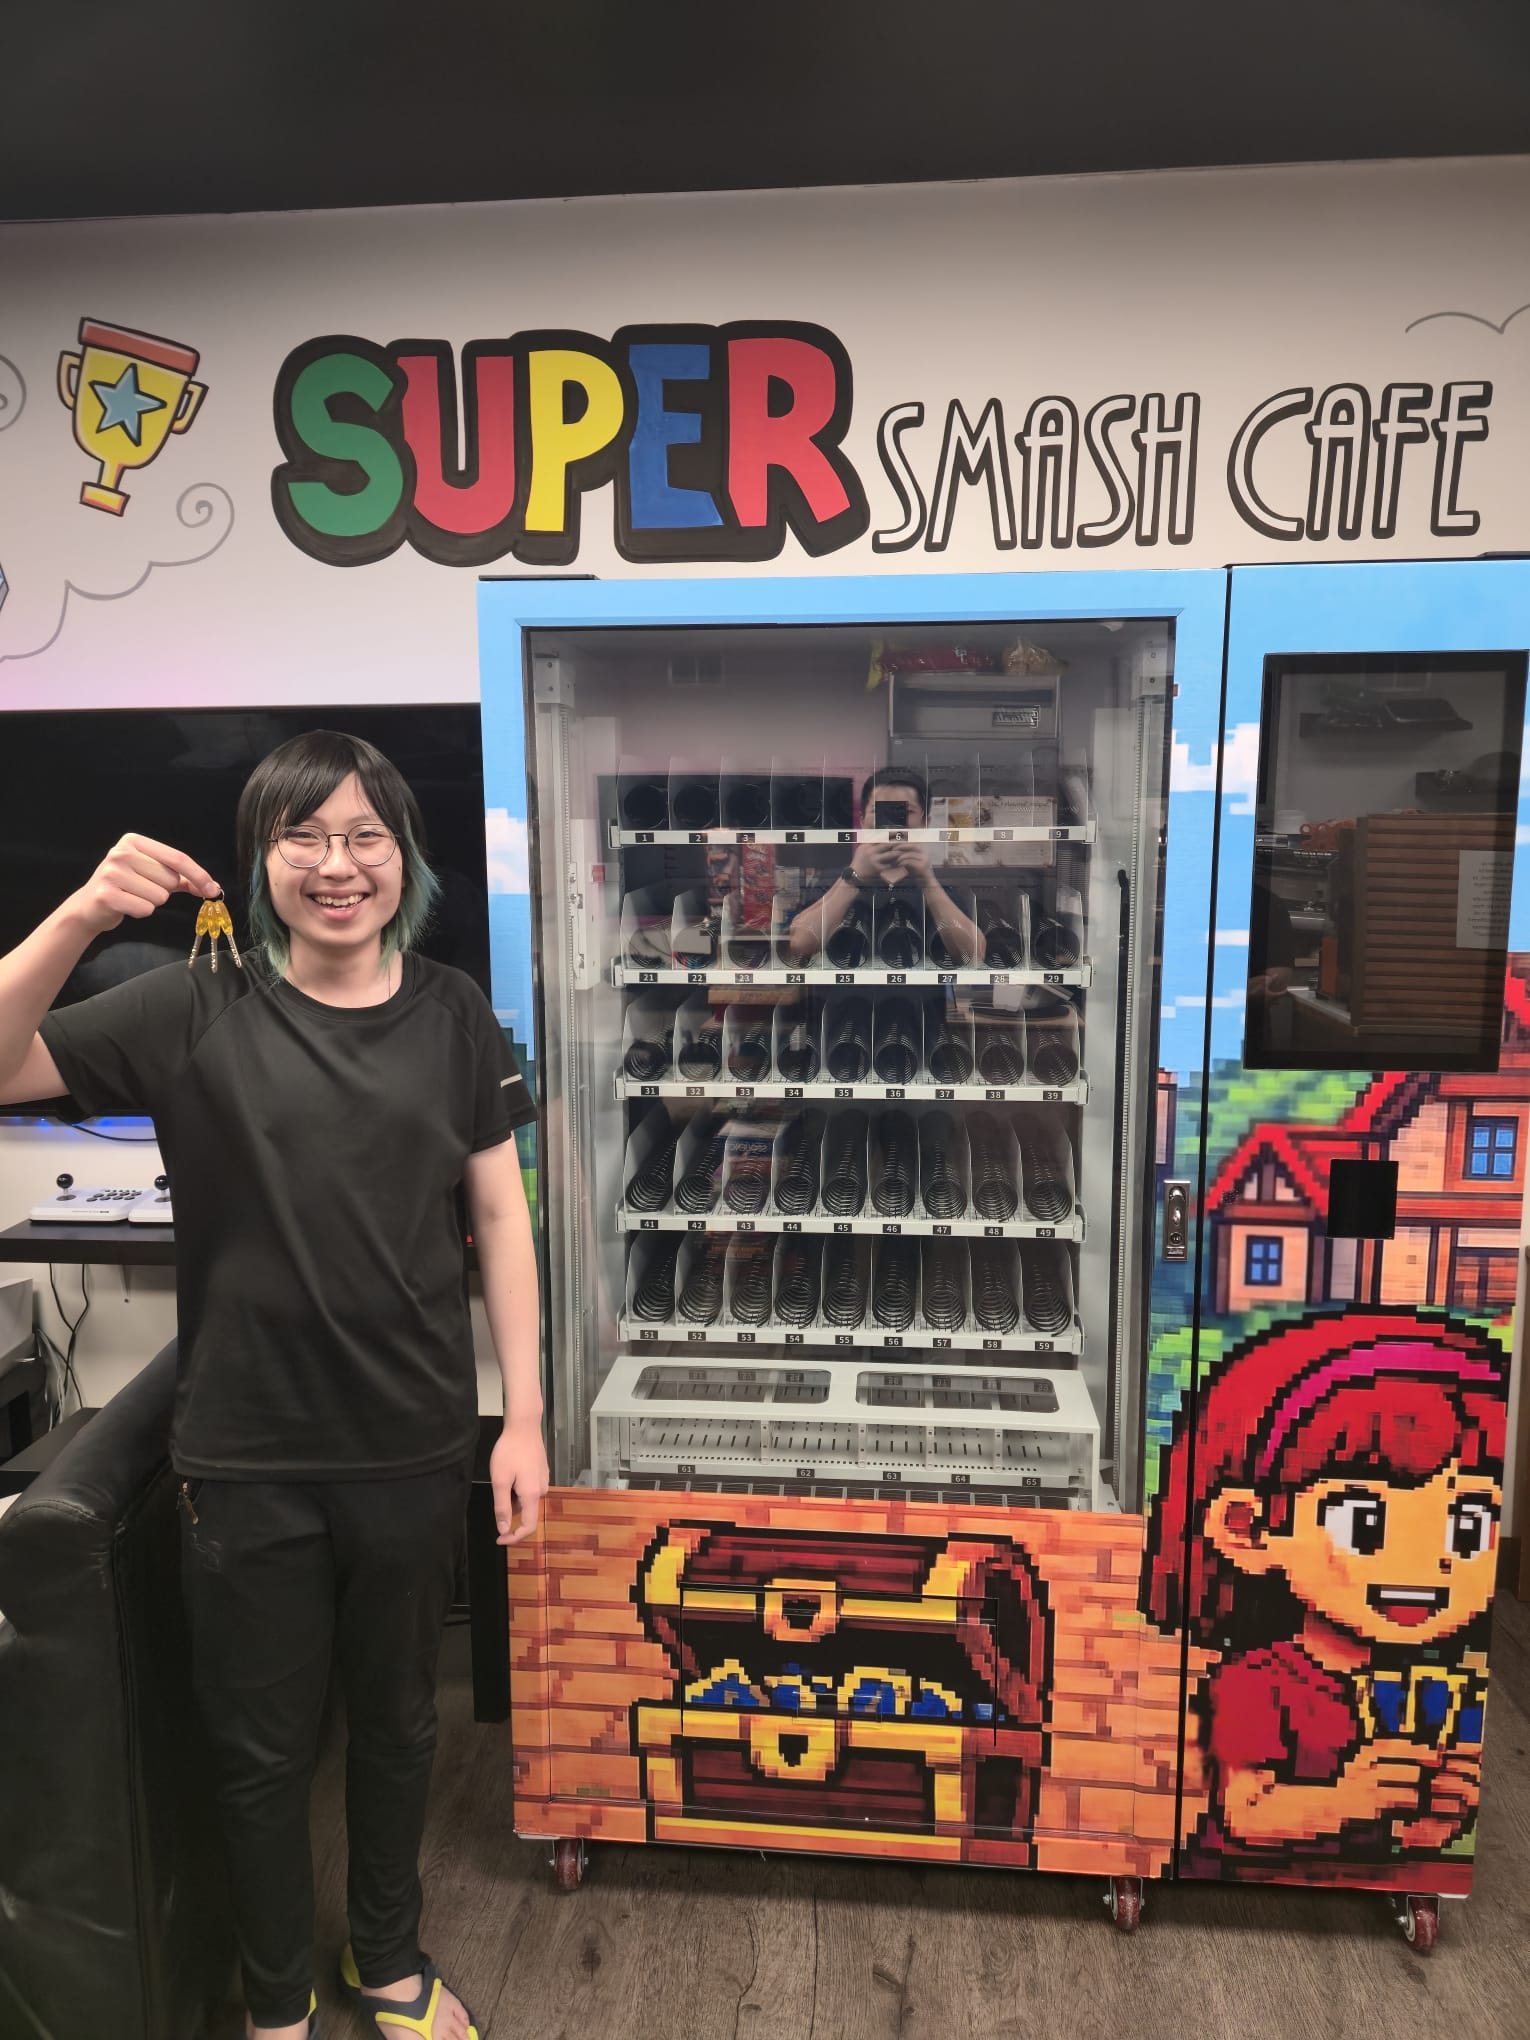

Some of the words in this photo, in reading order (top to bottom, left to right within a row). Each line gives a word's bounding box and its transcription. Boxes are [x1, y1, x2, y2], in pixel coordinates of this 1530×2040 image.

[272, 319, 869, 566] SUPER
[872, 392, 1200, 553] SMASH
[1227, 381, 1493, 541] CAFE
[642, 973, 655, 982] 21
[691, 974, 704, 983] 22
[738, 974, 750, 983] 23
[789, 974, 802, 983] 24
[839, 974, 851, 983] 25
[890, 974, 903, 983] 26
[941, 974, 954, 983] 27
[994, 975, 1005, 984] 28
[1047, 975, 1060, 983] 29
[644, 1086, 656, 1095] 31
[689, 1087, 702, 1096] 32
[739, 1088, 751, 1096] 33
[788, 1088, 800, 1097] 34
[838, 1088, 850, 1097] 35
[889, 1089, 902, 1098] 36
[939, 1090, 951, 1098] 37
[989, 1090, 1001, 1099] 38
[1047, 1091, 1059, 1100] 39
[643, 1220, 656, 1229] 41
[691, 1221, 703, 1230] 42
[740, 1221, 752, 1230] 43
[786, 1223, 798, 1231] 44
[837, 1224, 849, 1232] 45
[886, 1224, 898, 1233] 46
[936, 1226, 948, 1235] 47
[987, 1227, 1000, 1236] 48
[1039, 1228, 1052, 1237] 49
[643, 1330, 656, 1339] 51
[691, 1332, 703, 1341] 52
[740, 1333, 753, 1342] 53
[788, 1334, 801, 1343] 54
[839, 1335, 851, 1344] 55
[887, 1337, 900, 1346] 56
[936, 1338, 949, 1347] 57
[986, 1340, 998, 1349] 58
[1038, 1342, 1050, 1350] 59
[799, 1469, 812, 1477] 62
[886, 1472, 898, 1480] 63
[954, 1474, 967, 1484] 64
[1025, 1477, 1038, 1487] 65
